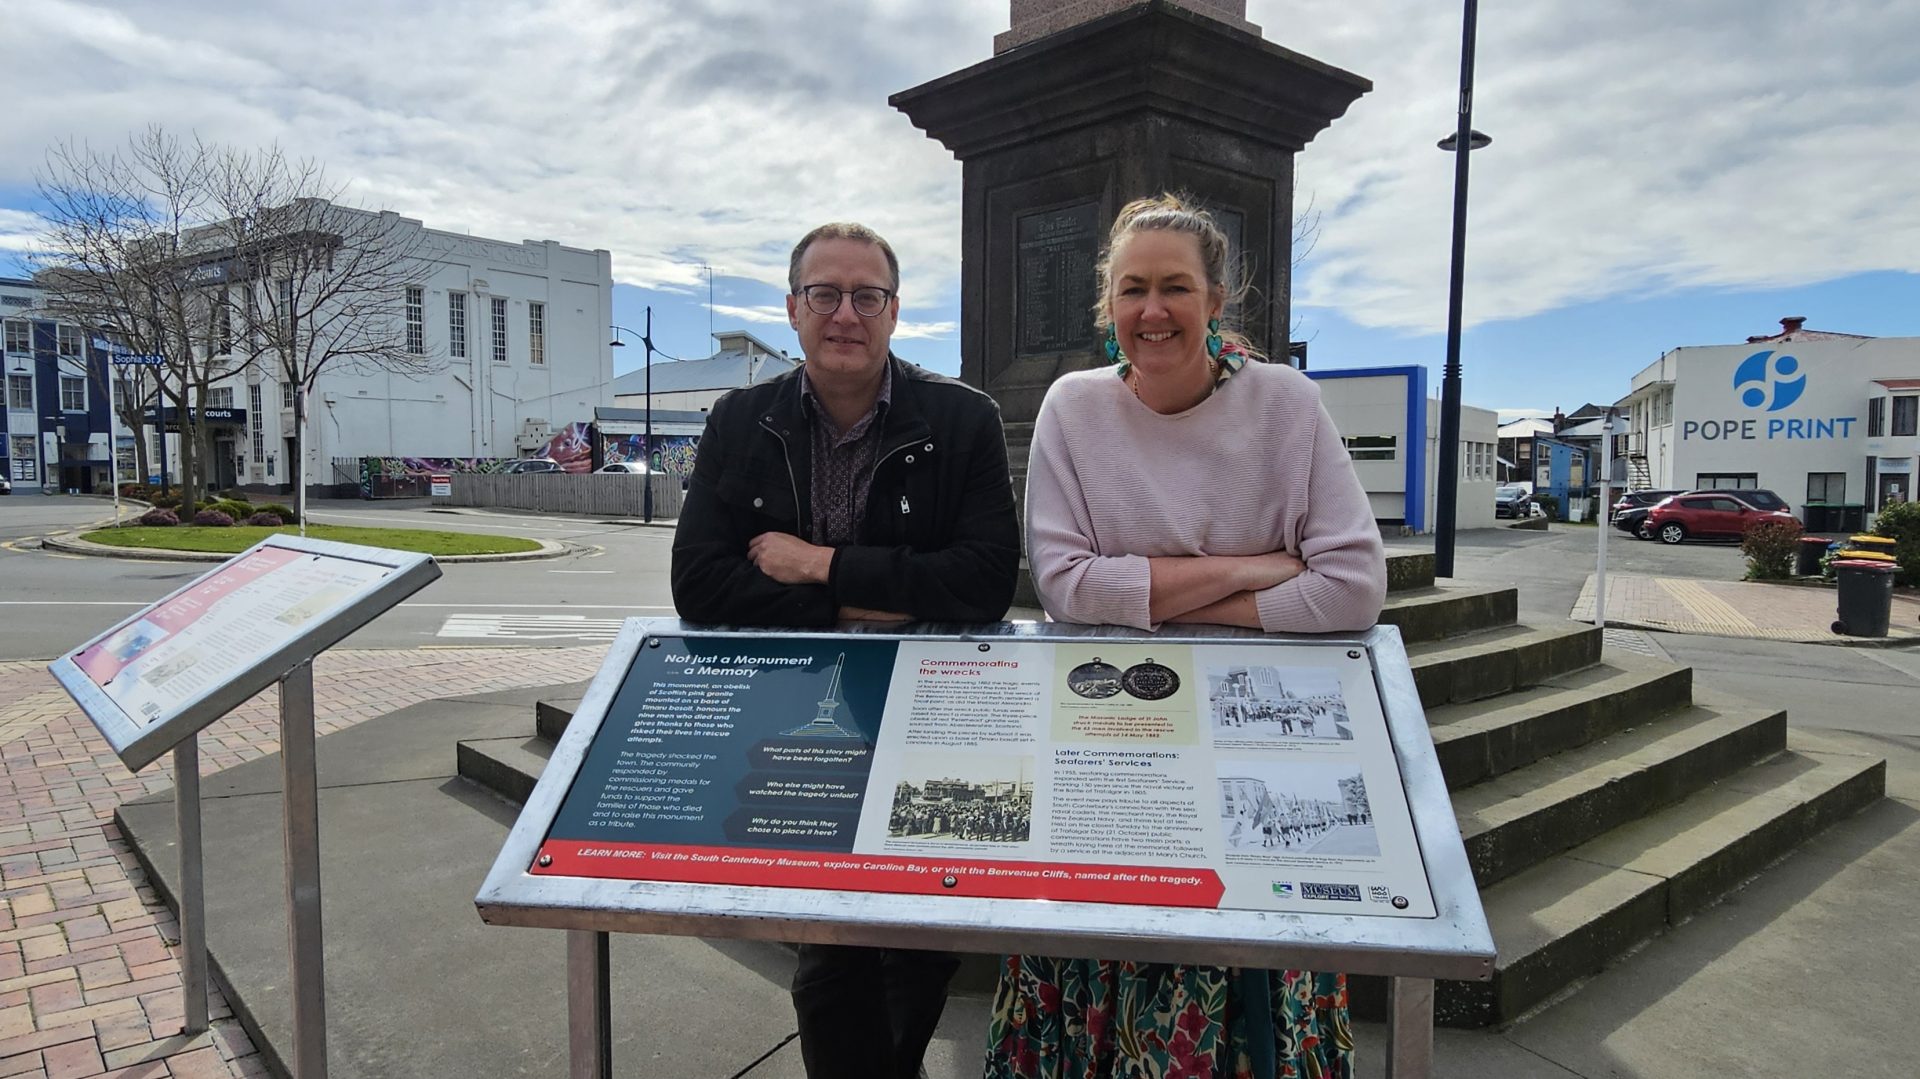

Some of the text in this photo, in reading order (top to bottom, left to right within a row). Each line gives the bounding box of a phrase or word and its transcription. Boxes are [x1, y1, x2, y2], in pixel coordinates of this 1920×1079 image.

[115, 354, 155, 364] Sophia St
[190, 408, 232, 418] Hcourts
[1683, 417, 1857, 441] POPE PRINT
[664, 654, 814, 666] Not just a Monument
[921, 659, 1019, 669] Commemorating
[684, 667, 695, 675] a
[696, 666, 759, 678] Memory
[656, 720, 684, 728] thanks
[626, 736, 664, 744] attempts.
[635, 751, 668, 760] tragedy
[825, 748, 844, 756] story
[1055, 749, 1180, 760] Later Commemorations:
[640, 759, 655, 767] The
[655, 761, 701, 769] community
[1055, 758, 1152, 767] Seafarers' Services
[608, 776, 667, 785] commissioning
[698, 778, 712, 786] for
[618, 785, 653, 793] rescuers
[671, 787, 695, 795] gave
[797, 790, 829, 799] tragedy
[600, 792, 623, 800] funds
[623, 793, 634, 801] to
[596, 801, 627, 809] families
[627, 802, 638, 810] of
[638, 803, 662, 811] those
[642, 812, 657, 820] this
[607, 820, 636, 828] tribute.
[751, 817, 770, 826] Why
[798, 819, 819, 827] think
[819, 820, 839, 829] they
[746, 826, 772, 834] chose
[813, 829, 838, 837] here?
[577, 848, 613, 857] LEARN
[612, 849, 647, 859] MORE:
[651, 851, 673, 860] Visit
[672, 853, 690, 861] the
[690, 853, 720, 862] South
[721, 855, 776, 866] Canterbury
[776, 858, 821, 868] Museum,
[823, 861, 862, 870] explore
[862, 862, 906, 872] Caroline
[906, 864, 929, 874] Bay,
[945, 865, 968, 875] visit
[968, 867, 986, 875] the
[987, 867, 1040, 878] Benvenue
[1041, 869, 1072, 880] Cliffs,
[1074, 872, 1111, 881] named
[1112, 873, 1139, 882] after
[1139, 874, 1158, 883] the
[1159, 875, 1203, 886] tragedy.
[1303, 884, 1358, 896] MUSEUM
